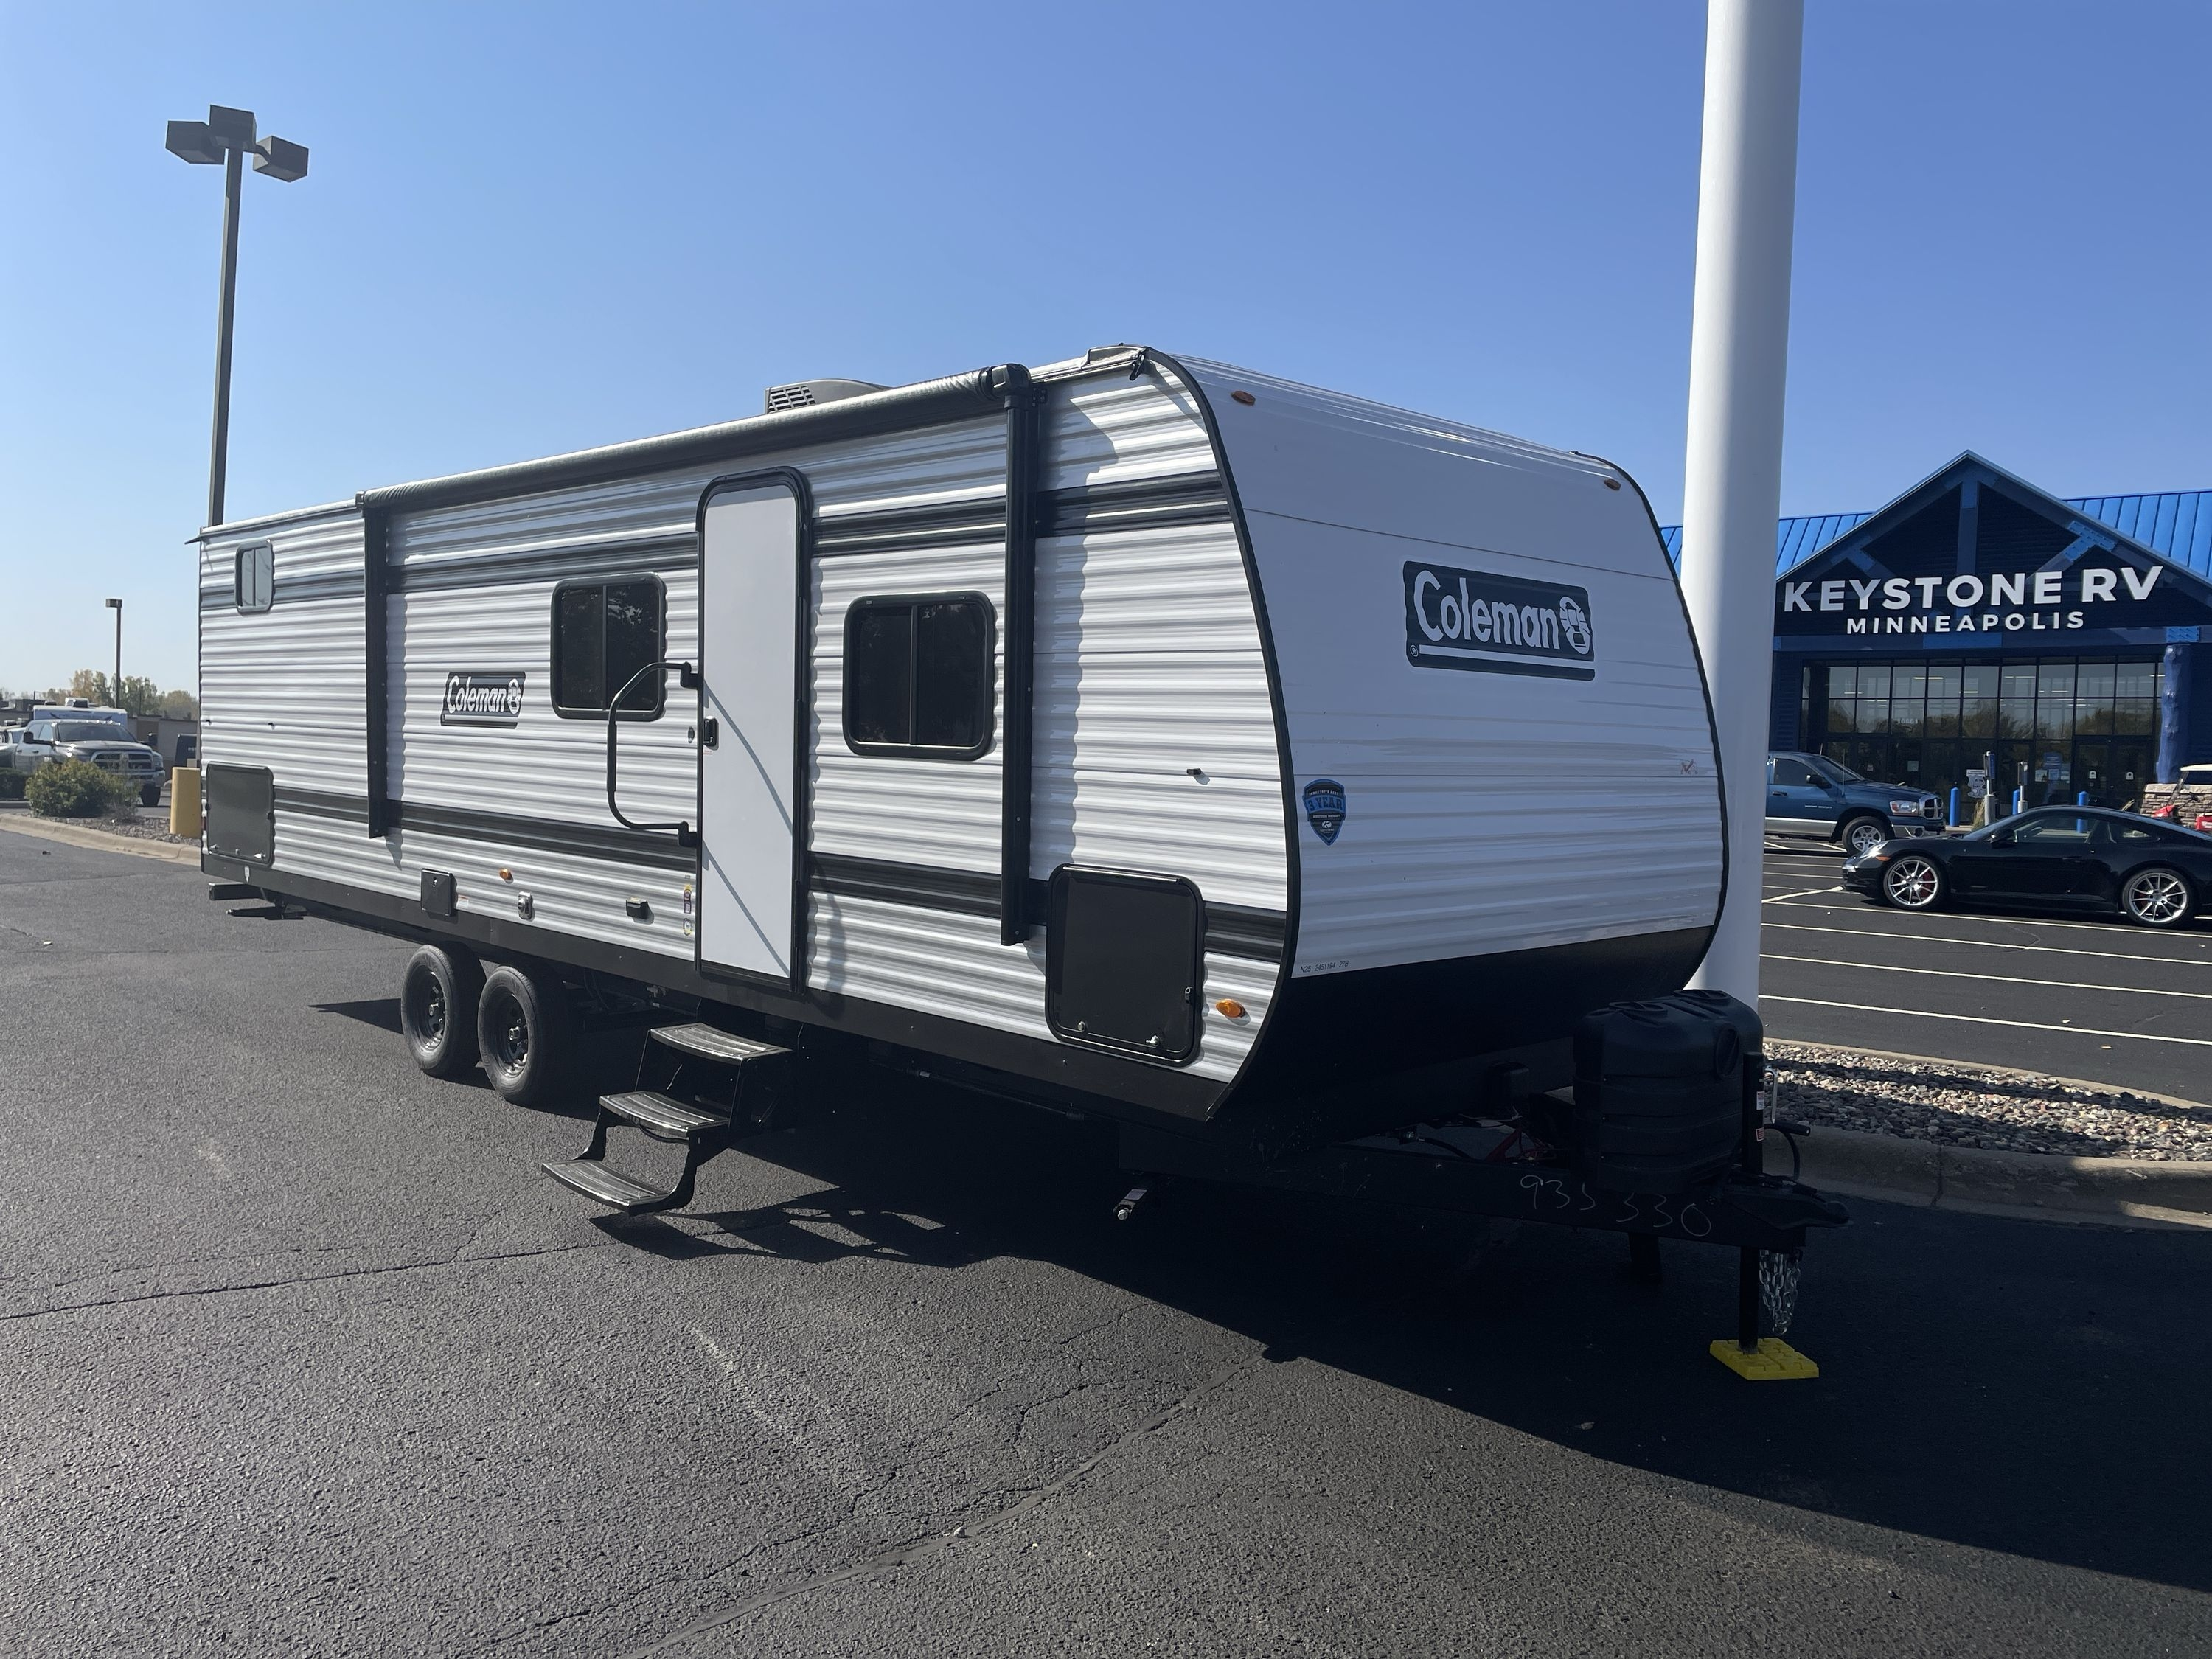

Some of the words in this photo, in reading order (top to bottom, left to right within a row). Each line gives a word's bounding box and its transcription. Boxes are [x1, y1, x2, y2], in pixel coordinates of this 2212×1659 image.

[1784, 570, 2062, 613] KEYSTONE
[2081, 565, 2164, 602] RV
[1413, 570, 1561, 650] Coleman
[1846, 611, 2084, 635] MINNEAPOLIS
[447, 675, 507, 714] Coleman
[1307, 799, 1315, 812] 3
[1315, 796, 1343, 810] YEAR
